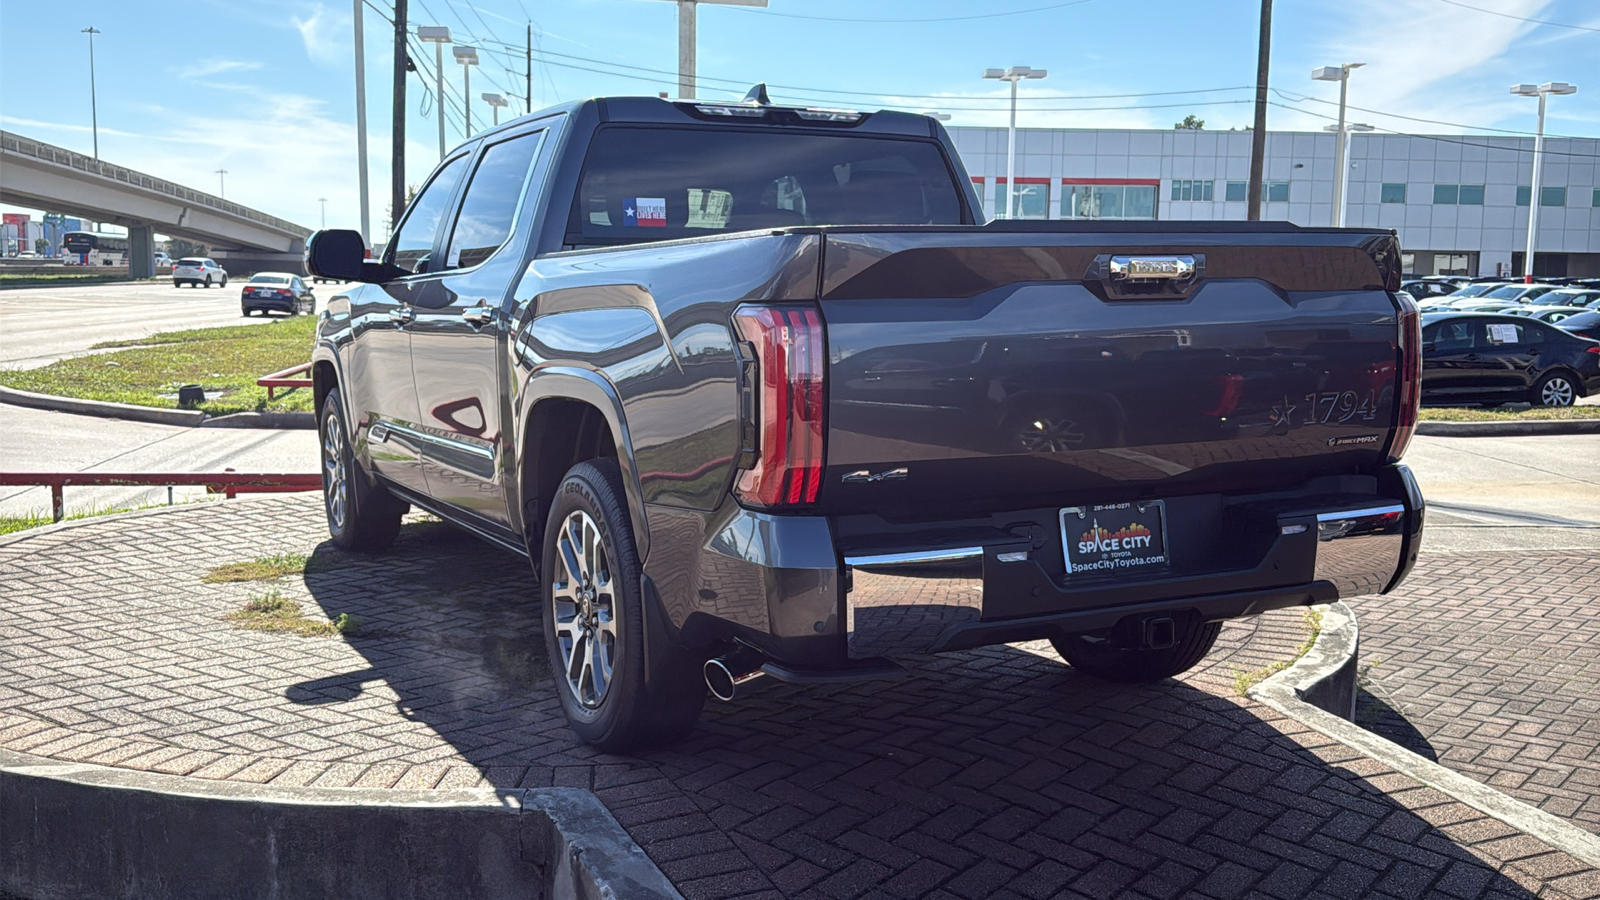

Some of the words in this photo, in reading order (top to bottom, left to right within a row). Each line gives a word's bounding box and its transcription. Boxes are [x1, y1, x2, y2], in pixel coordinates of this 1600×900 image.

[1134, 261, 1174, 272] TOYOTA
[1303, 389, 1377, 425] 1794
[1078, 530, 1120, 554] SPACE
[1122, 535, 1151, 549] CITY
[1072, 555, 1164, 572] SpaceCityToyota.com
